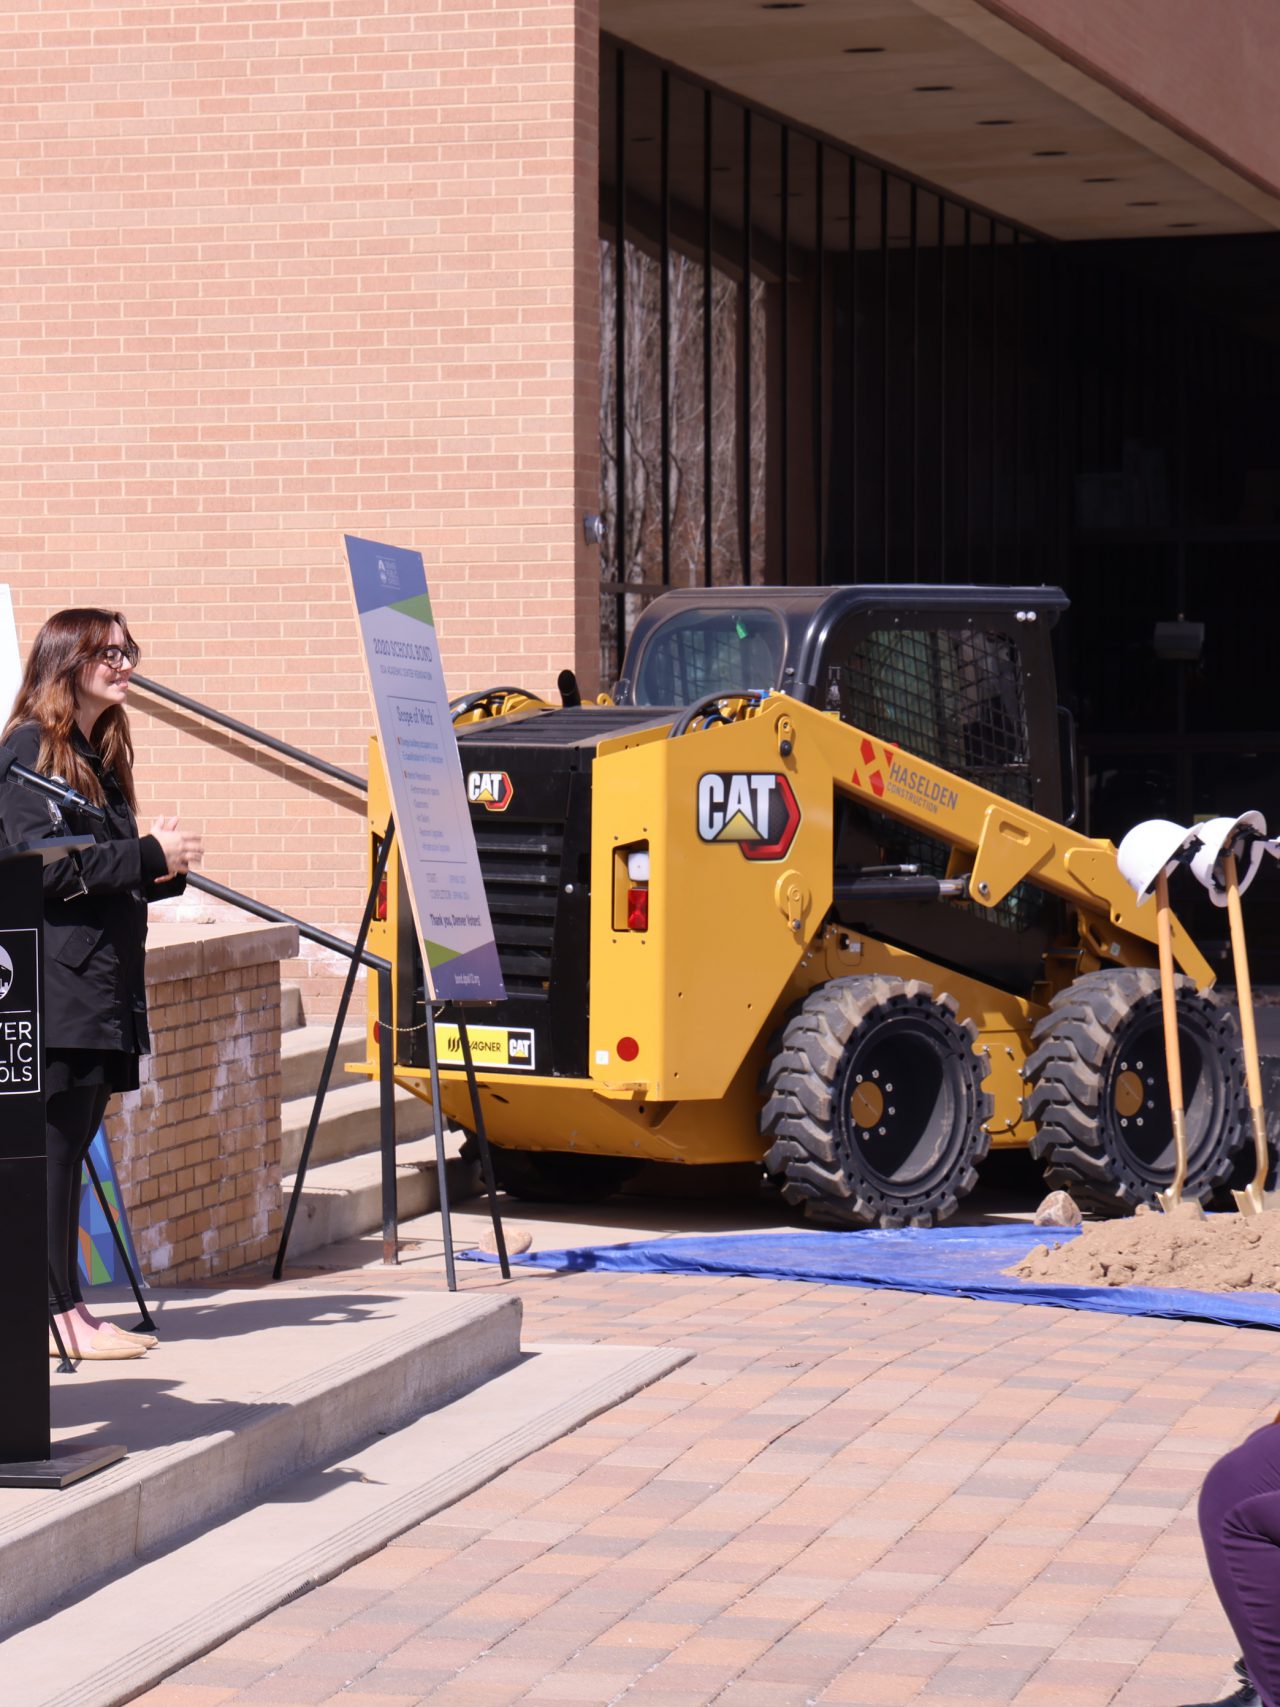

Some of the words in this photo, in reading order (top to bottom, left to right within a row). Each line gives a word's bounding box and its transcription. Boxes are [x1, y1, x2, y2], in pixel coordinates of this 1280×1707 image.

[373, 638, 391, 656] 2020
[390, 640, 416, 660] SCHOOL
[414, 644, 433, 662] BOND
[396, 705, 413, 727] Scope
[412, 706, 420, 724] of
[419, 709, 434, 725] Work
[469, 772, 502, 801] CAT
[887, 782, 938, 814] CONSTRUCTION
[889, 762, 959, 811] HASELDEN
[699, 774, 776, 840] CAT
[429, 913, 443, 926] Thank
[451, 914, 467, 927] Denver
[509, 1038, 531, 1058] CAT
